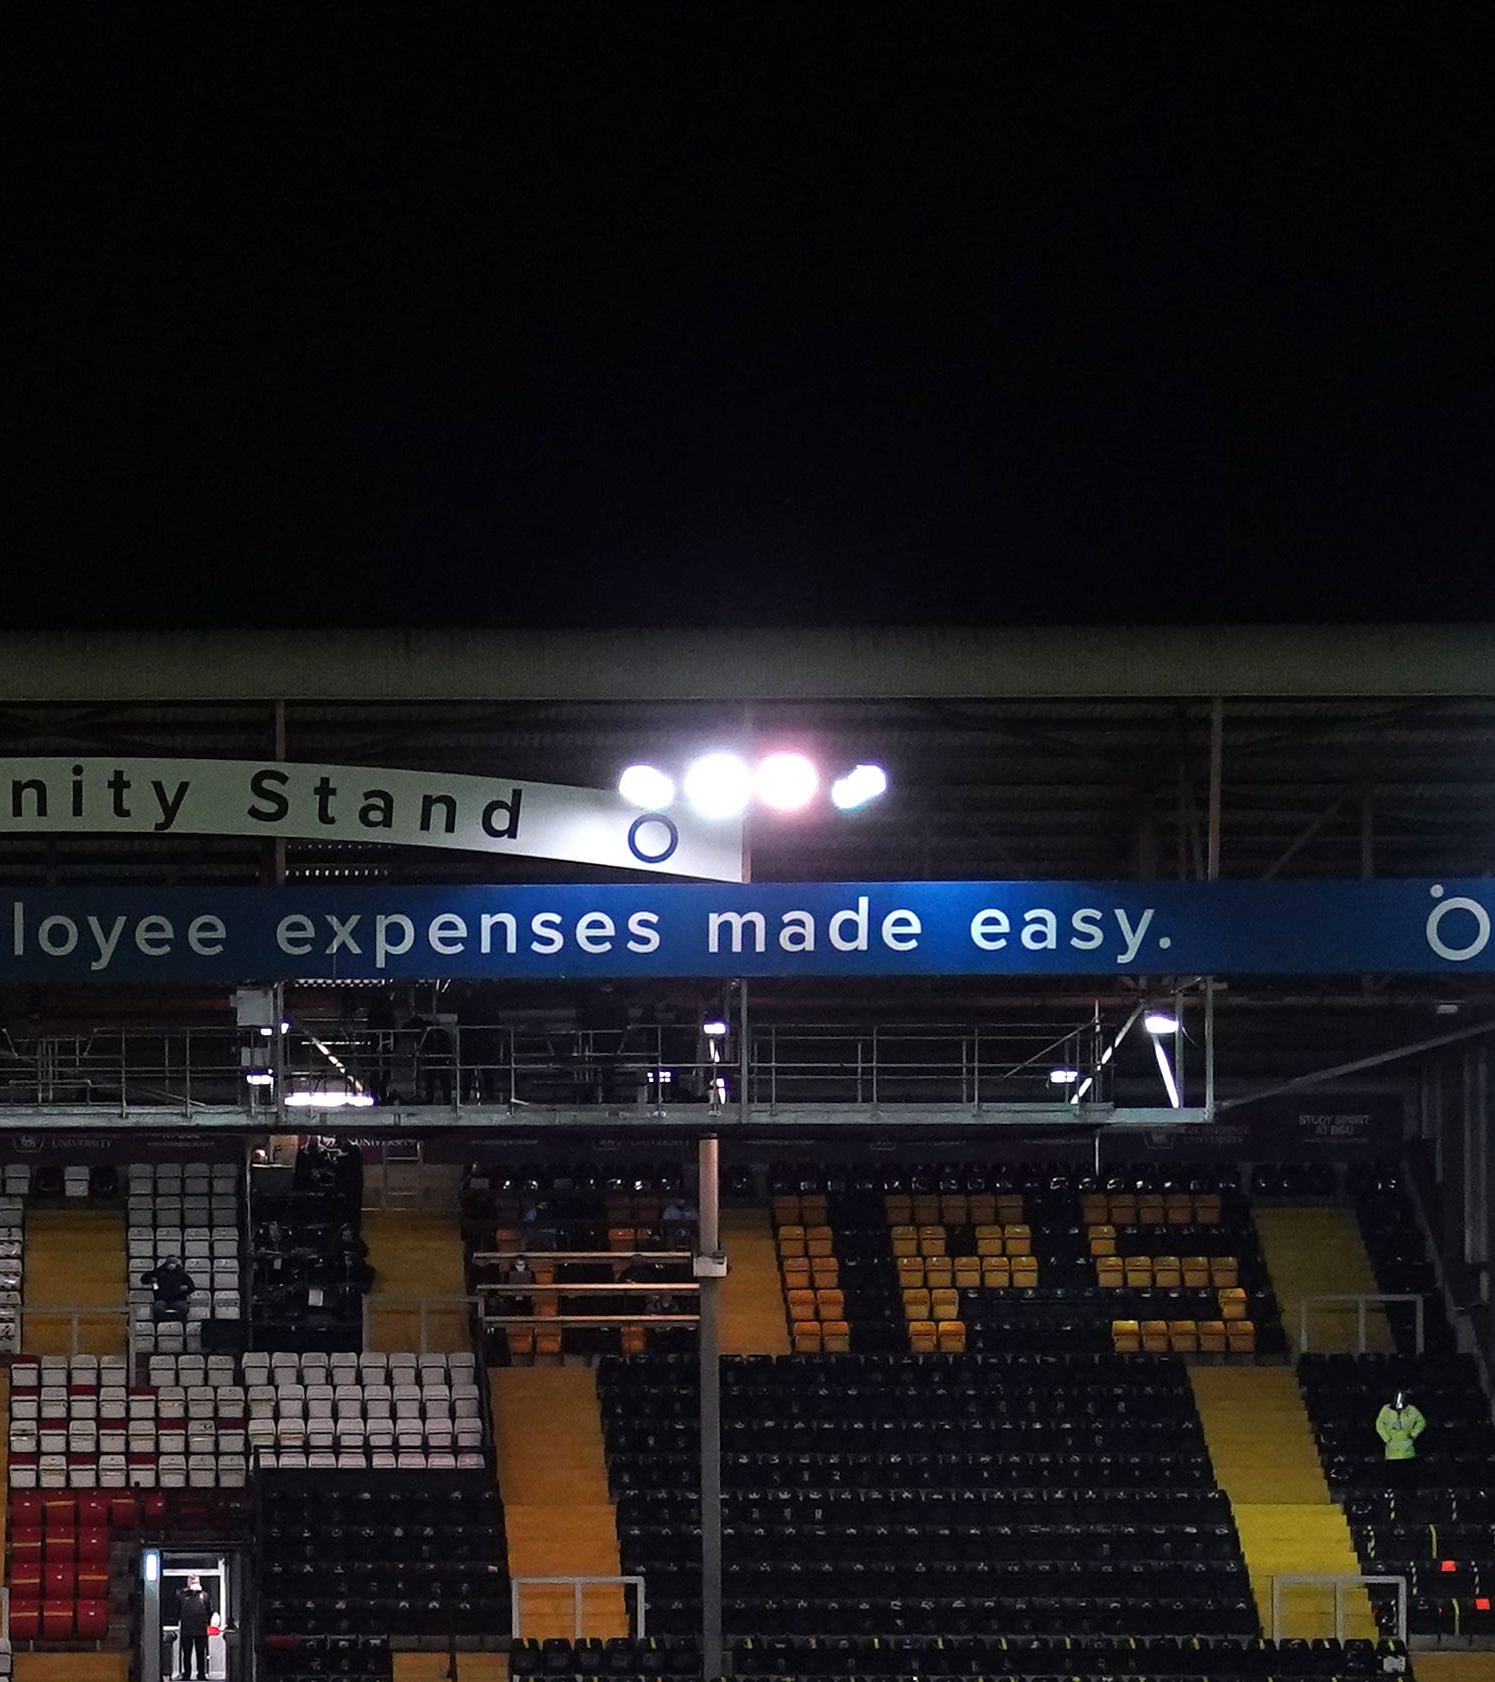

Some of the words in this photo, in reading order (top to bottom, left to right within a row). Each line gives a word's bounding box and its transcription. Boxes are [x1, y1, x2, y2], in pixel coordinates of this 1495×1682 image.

[248, 769, 523, 840] Stand
[276, 909, 662, 968] expenses
[707, 895, 923, 954] made
[970, 906, 1172, 964] easy.
